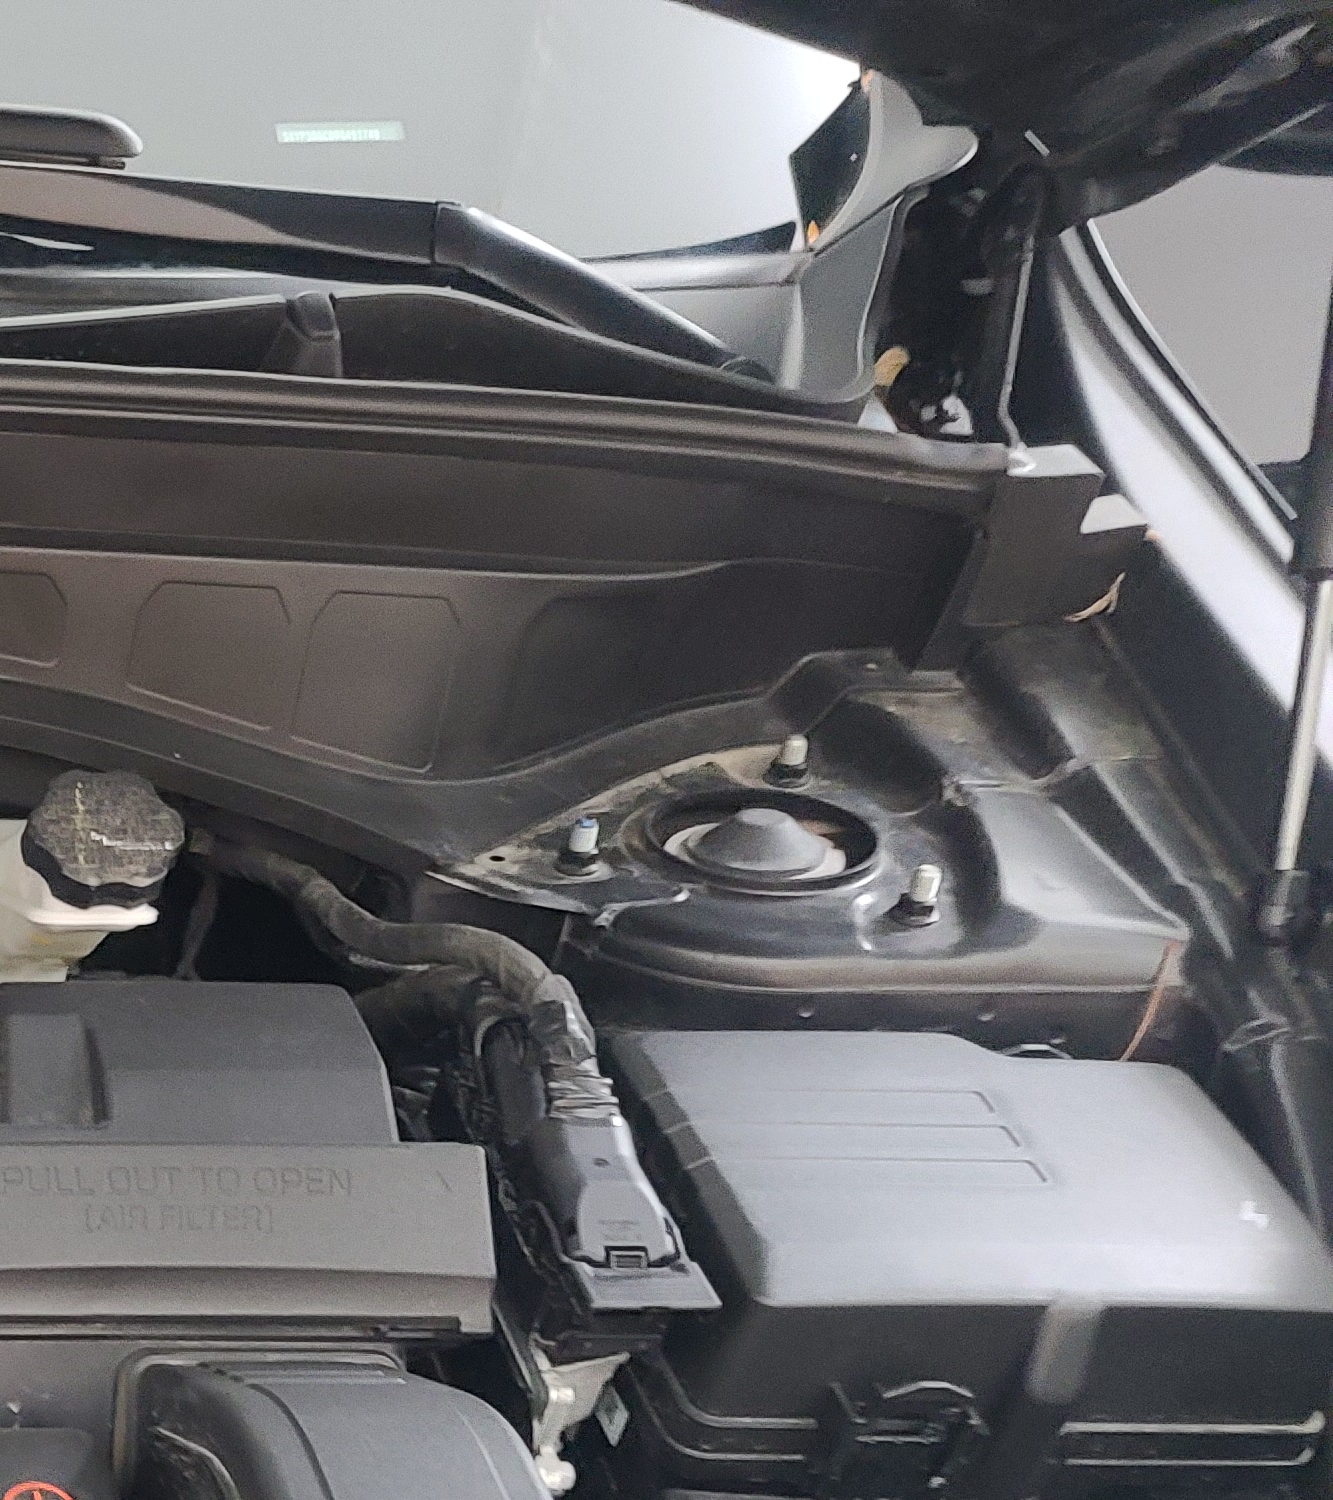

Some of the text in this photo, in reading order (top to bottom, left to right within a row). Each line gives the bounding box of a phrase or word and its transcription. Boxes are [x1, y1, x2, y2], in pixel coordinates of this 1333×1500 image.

[1, 1165, 353, 1198] PULL OUT TO OPEN
